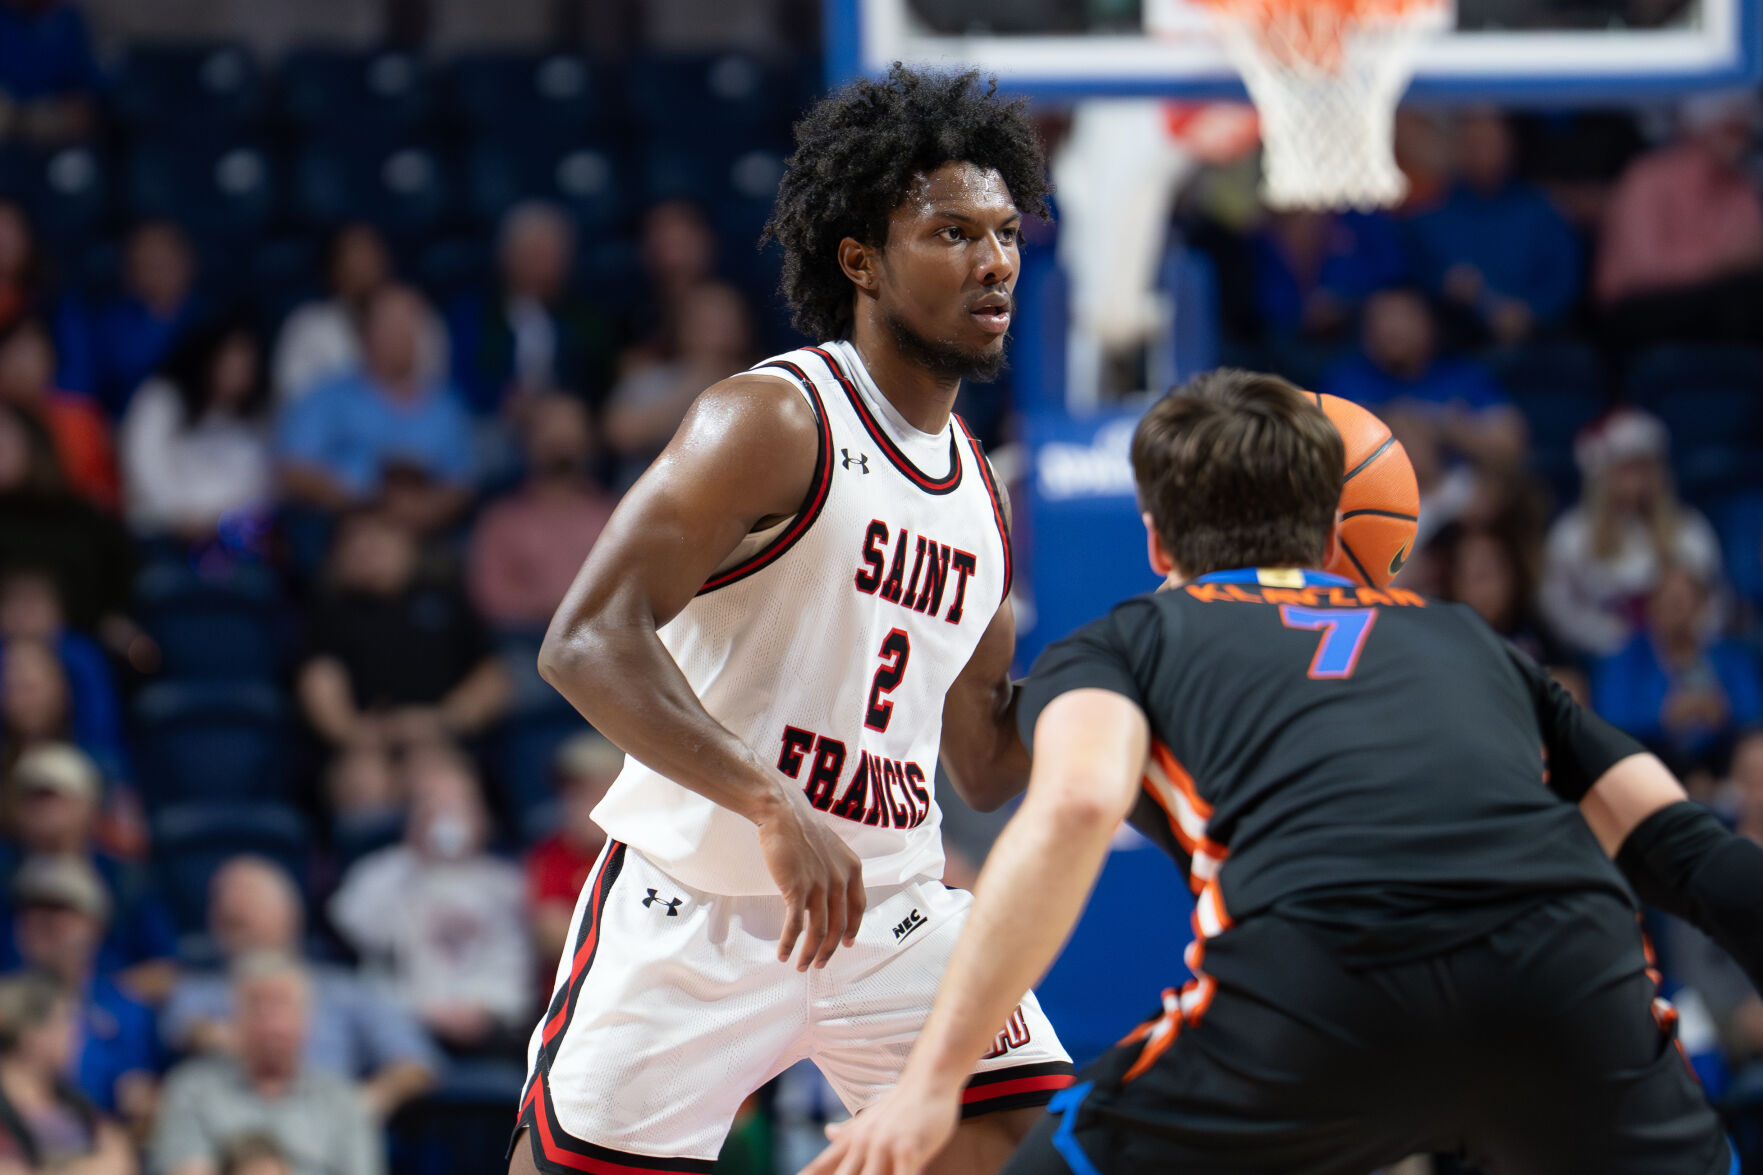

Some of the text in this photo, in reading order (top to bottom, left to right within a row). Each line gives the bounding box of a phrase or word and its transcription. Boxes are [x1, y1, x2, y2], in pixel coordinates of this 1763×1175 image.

[855, 519, 977, 625] SAINT
[864, 627, 911, 733] 2
[1278, 603, 1379, 680] 7
[777, 725, 931, 829] FRANCIS
[892, 908, 921, 939] NEC
